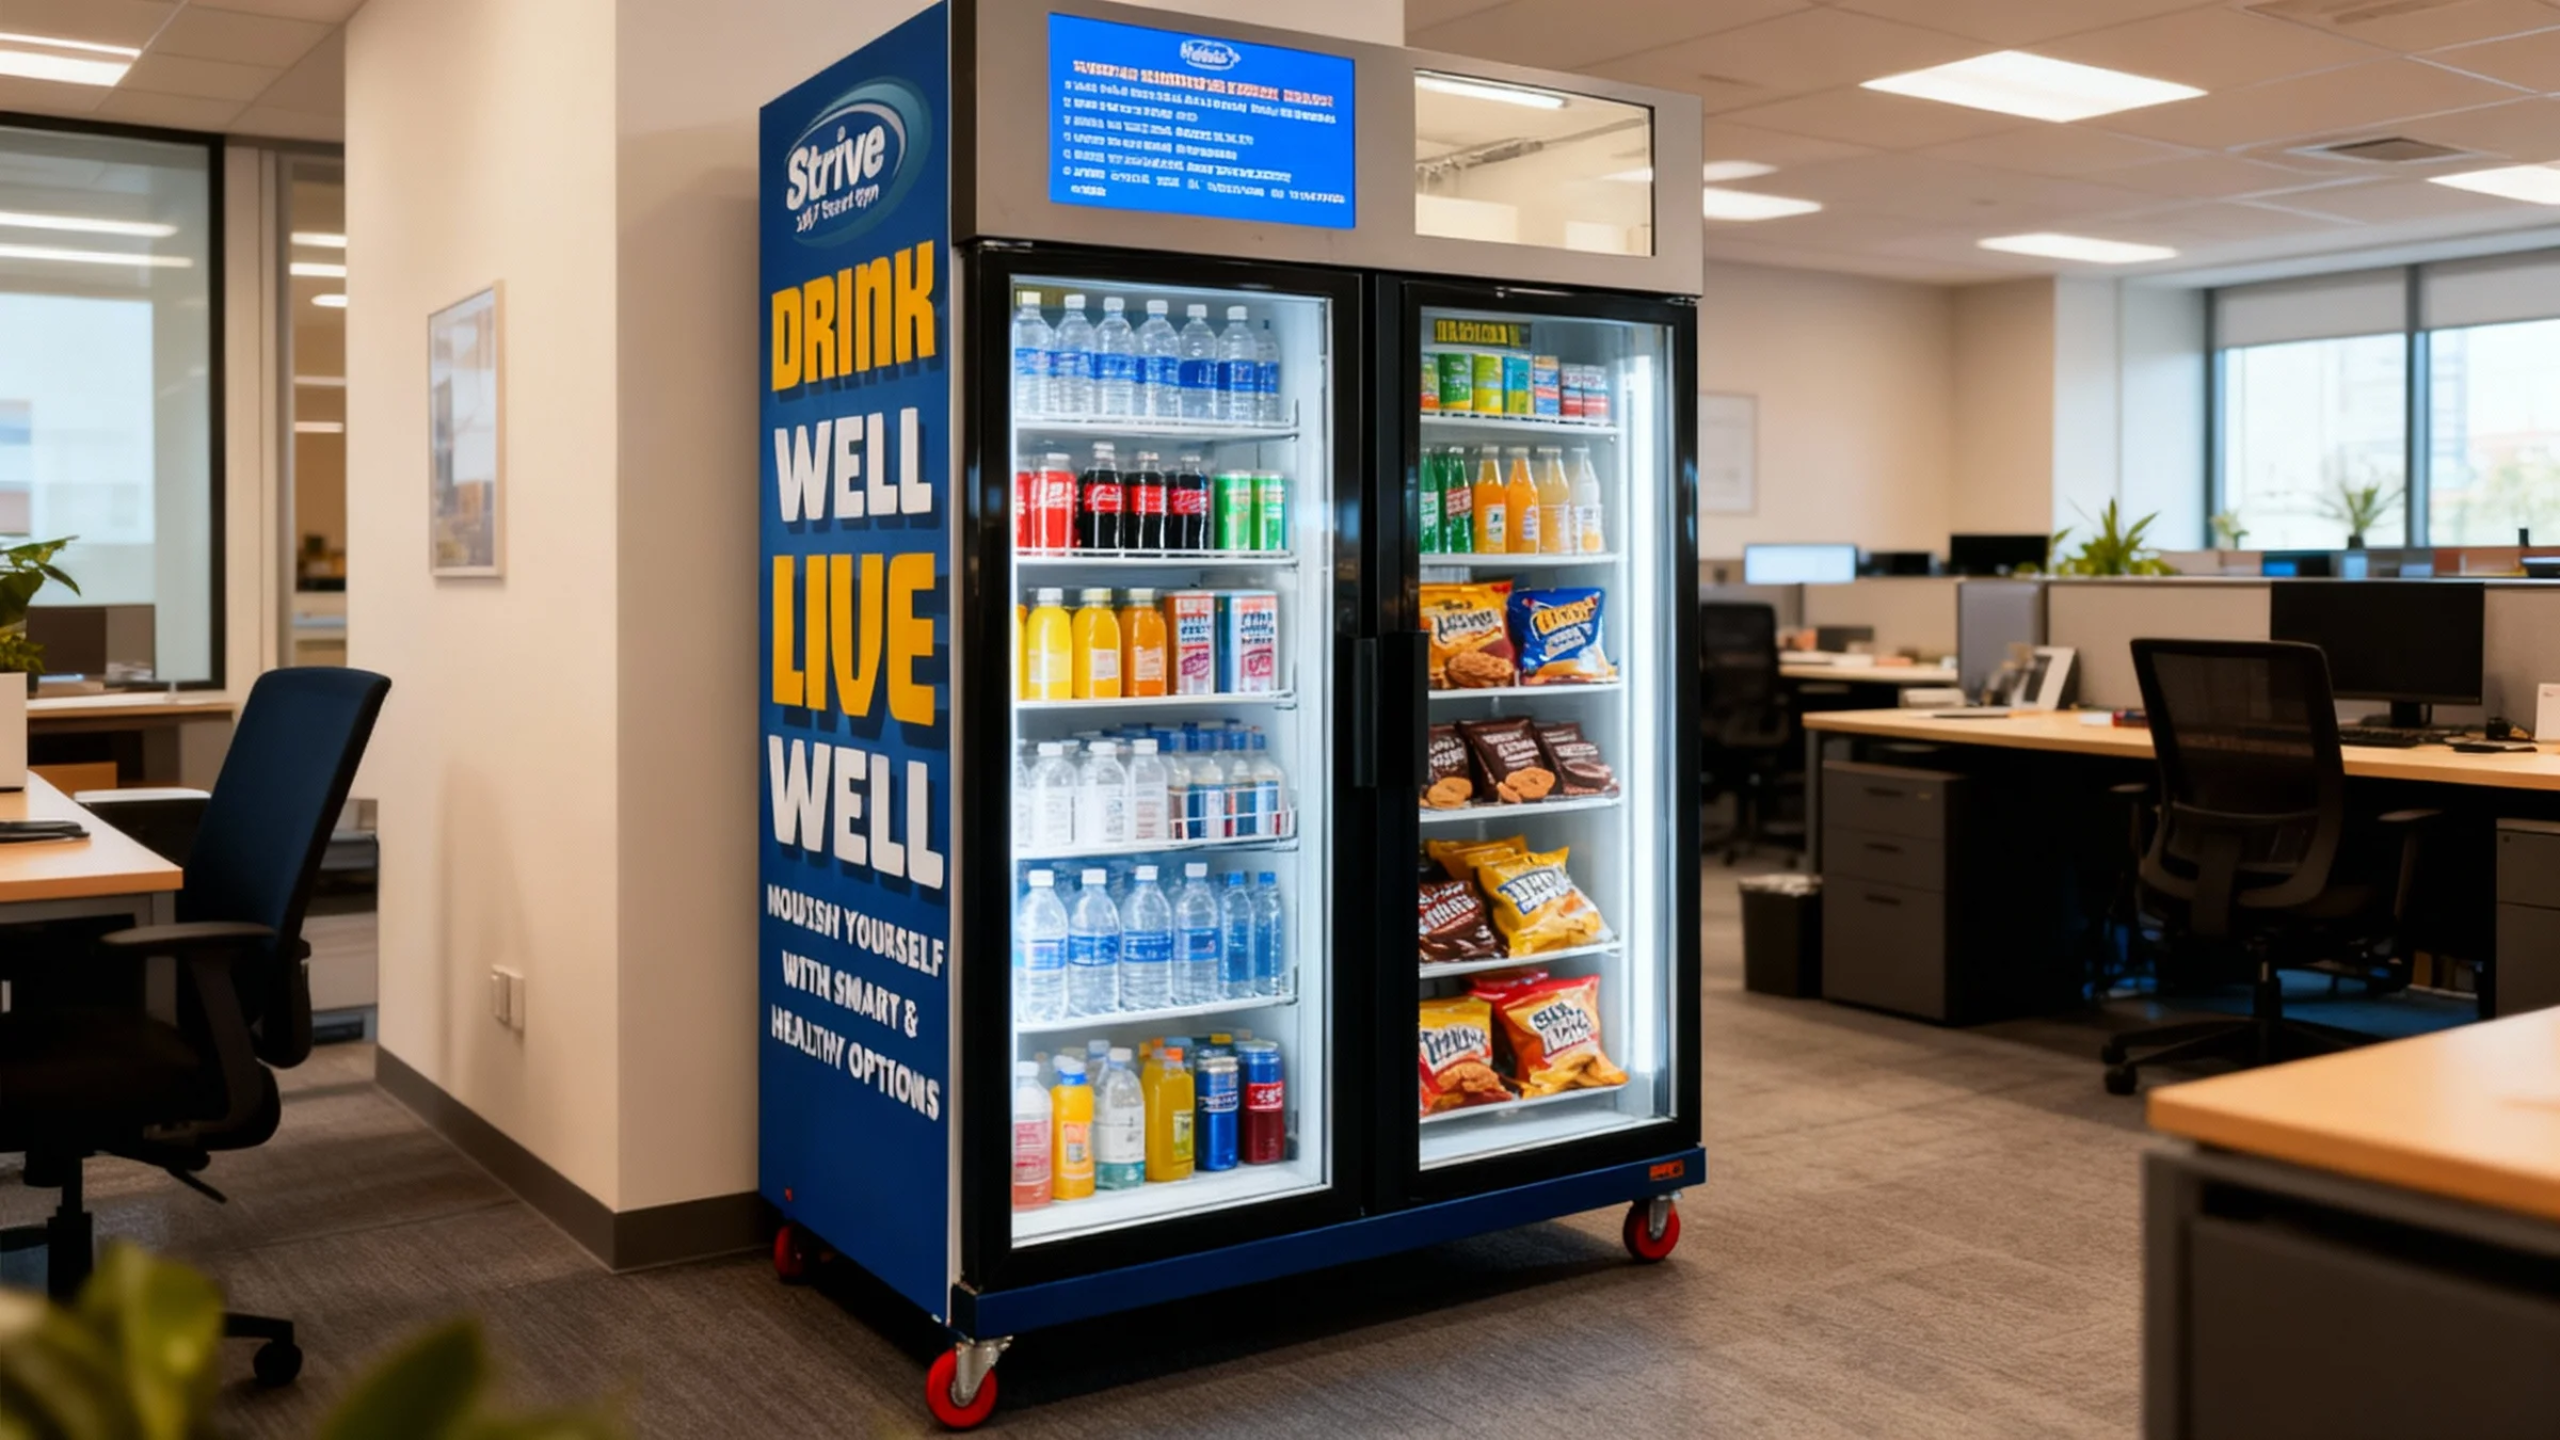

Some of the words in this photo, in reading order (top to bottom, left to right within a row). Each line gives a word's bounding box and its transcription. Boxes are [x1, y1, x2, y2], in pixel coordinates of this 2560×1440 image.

[786, 125, 886, 211] Strive
[771, 240, 936, 392] DRINK
[774, 407, 932, 522] WELL
[772, 552, 935, 726] LIVE
[768, 734, 944, 890] WELL
[782, 949, 831, 1001] WITH
[834, 970, 901, 1030] SMART
[904, 999, 919, 1038] &
[844, 907, 944, 978] YOURSELF
[771, 1004, 846, 1070] HEALTHY
[848, 1042, 940, 1122] OPTIONS
